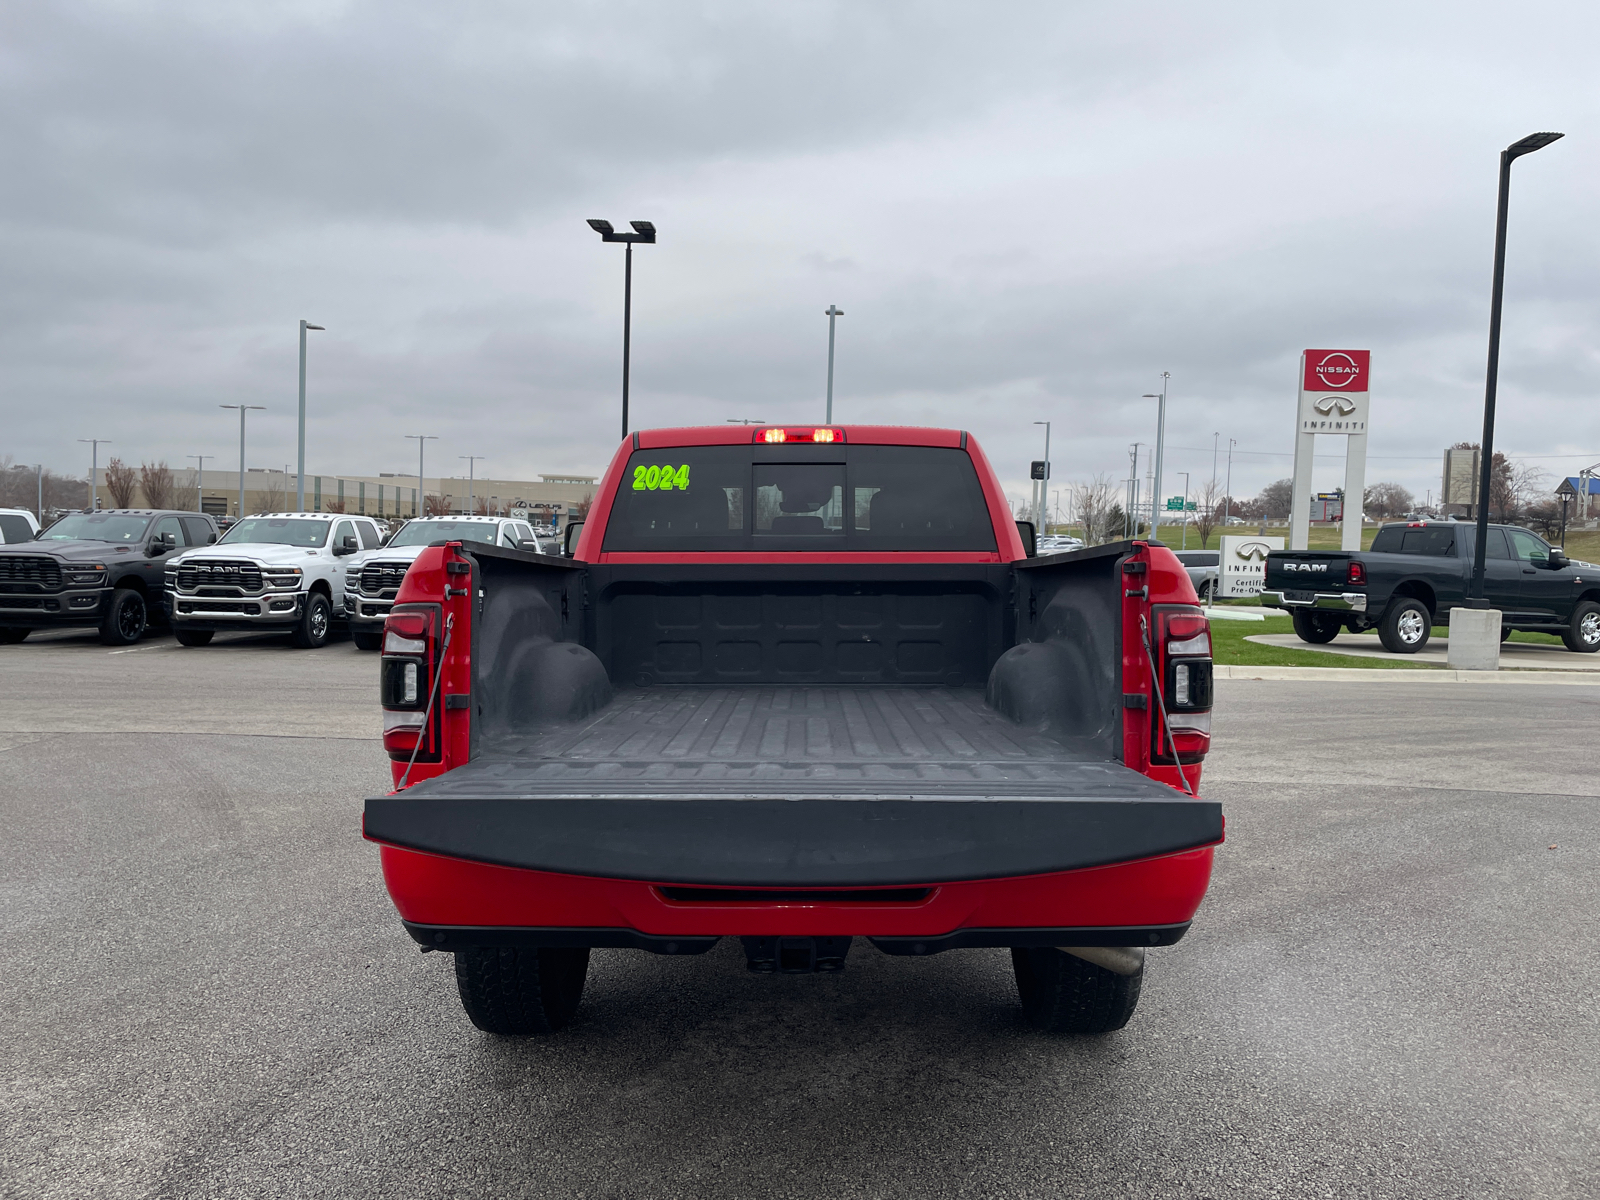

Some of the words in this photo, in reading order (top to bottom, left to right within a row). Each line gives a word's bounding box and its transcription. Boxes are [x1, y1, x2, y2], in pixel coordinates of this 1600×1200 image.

[1316, 366, 1359, 374] NISSAN
[1303, 420, 1365, 430] INFINITI
[632, 464, 690, 491] 2024
[1283, 563, 1328, 572] RAM
